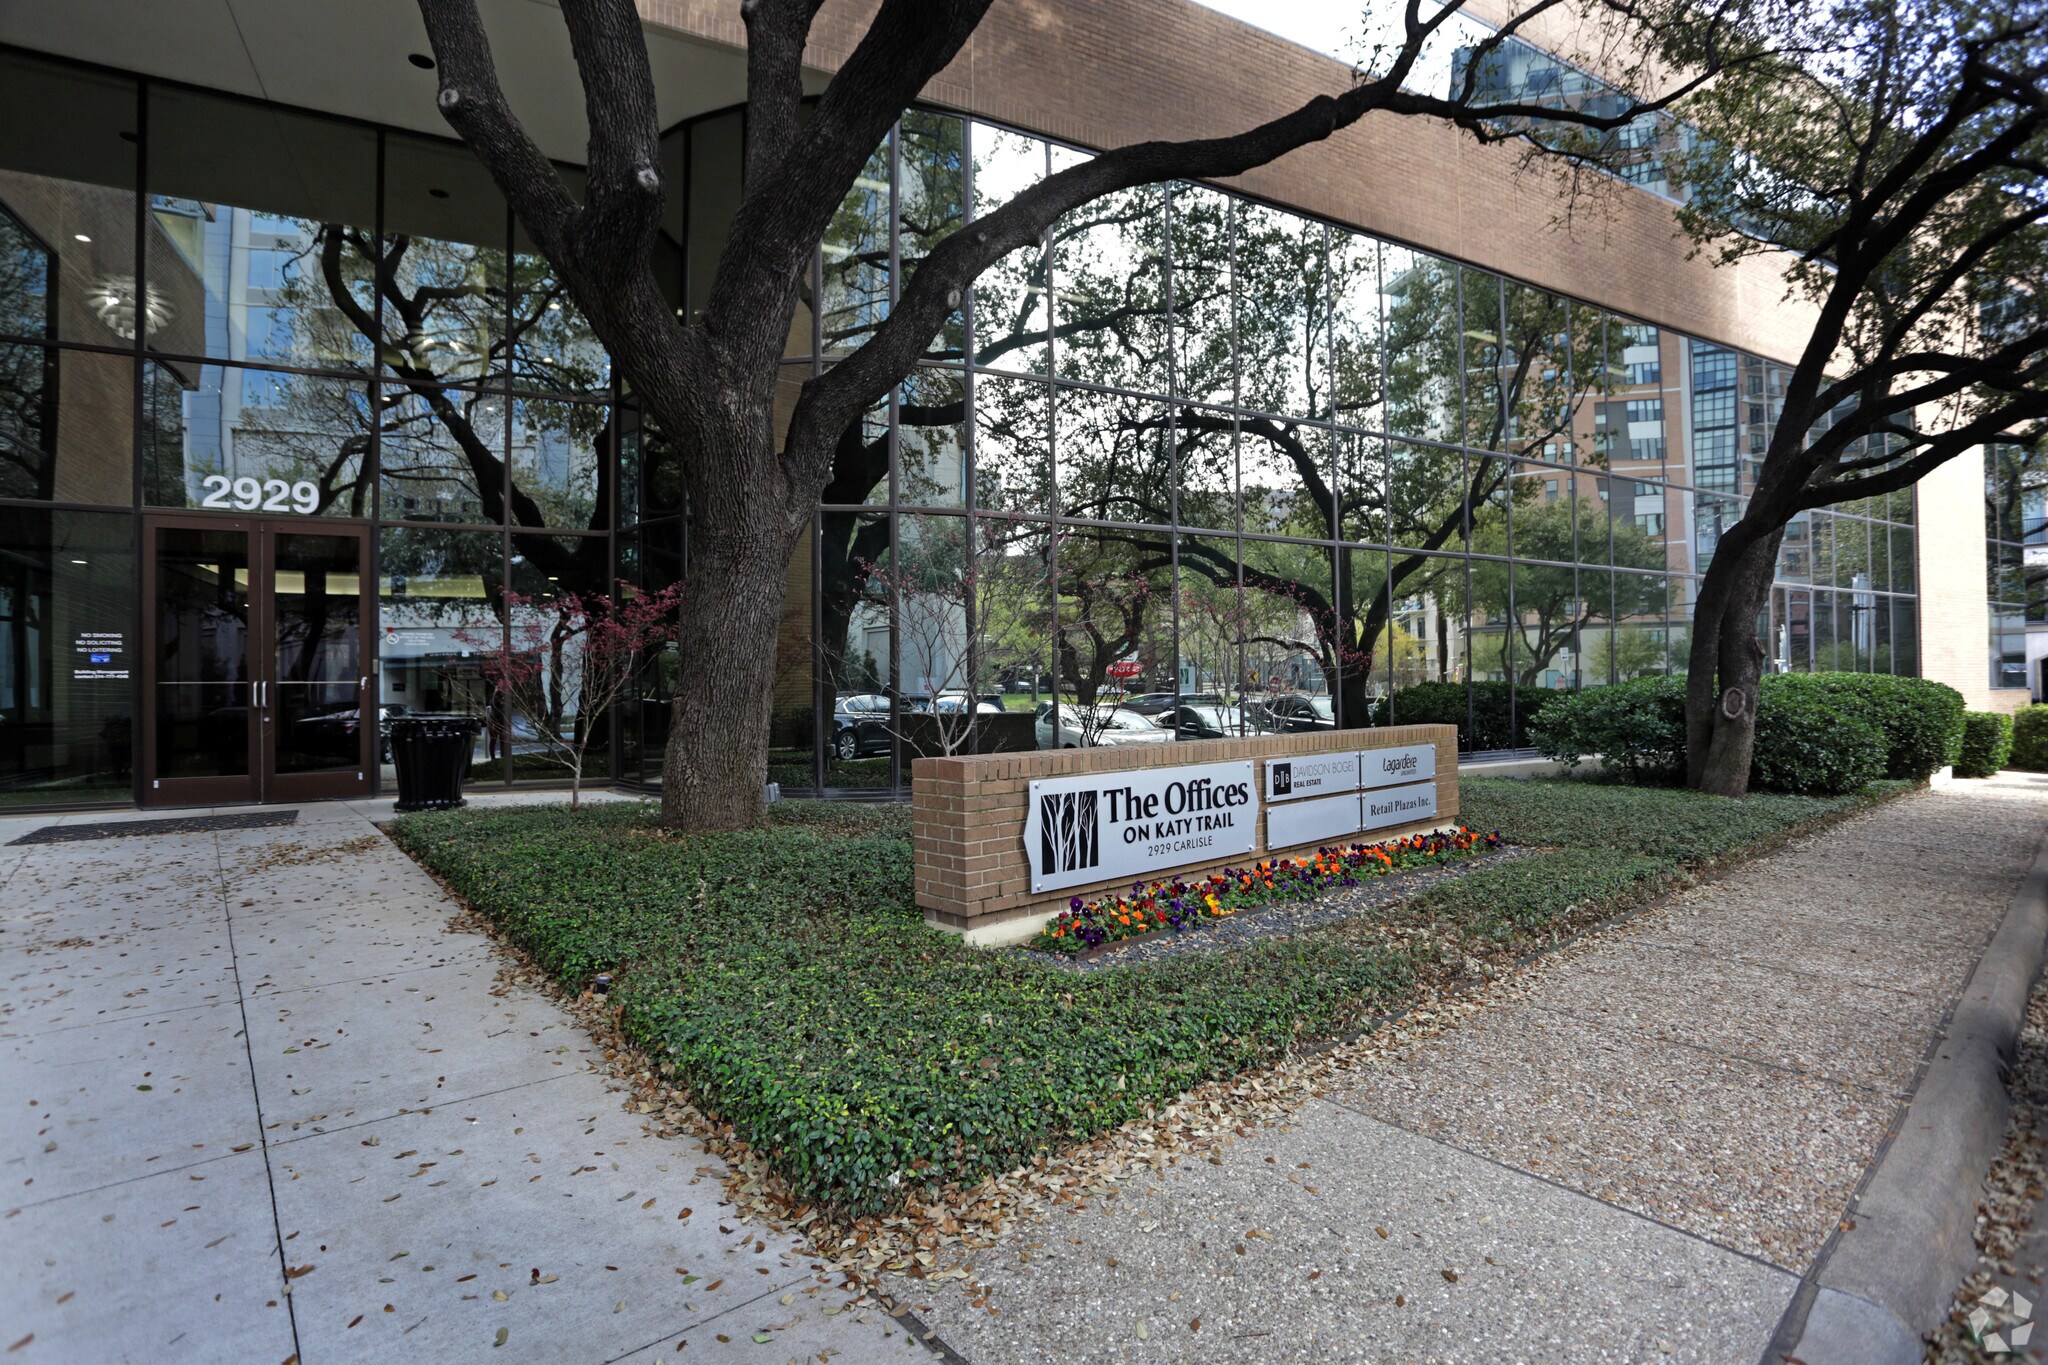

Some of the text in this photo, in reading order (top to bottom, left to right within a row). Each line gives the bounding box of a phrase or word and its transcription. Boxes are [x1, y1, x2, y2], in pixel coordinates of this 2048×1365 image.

[202, 475, 319, 514] 2929
[1293, 760, 1354, 778] DAVIDSON BOGEL
[1306, 778, 1322, 787] ESTATE
[1103, 778, 1249, 823] The Offices
[1370, 796, 1431, 816] Retail Plazas Inc.
[1123, 812, 1235, 844] ON KATY TRAIL
[1148, 836, 1213, 857] 2929 CARLISLE
